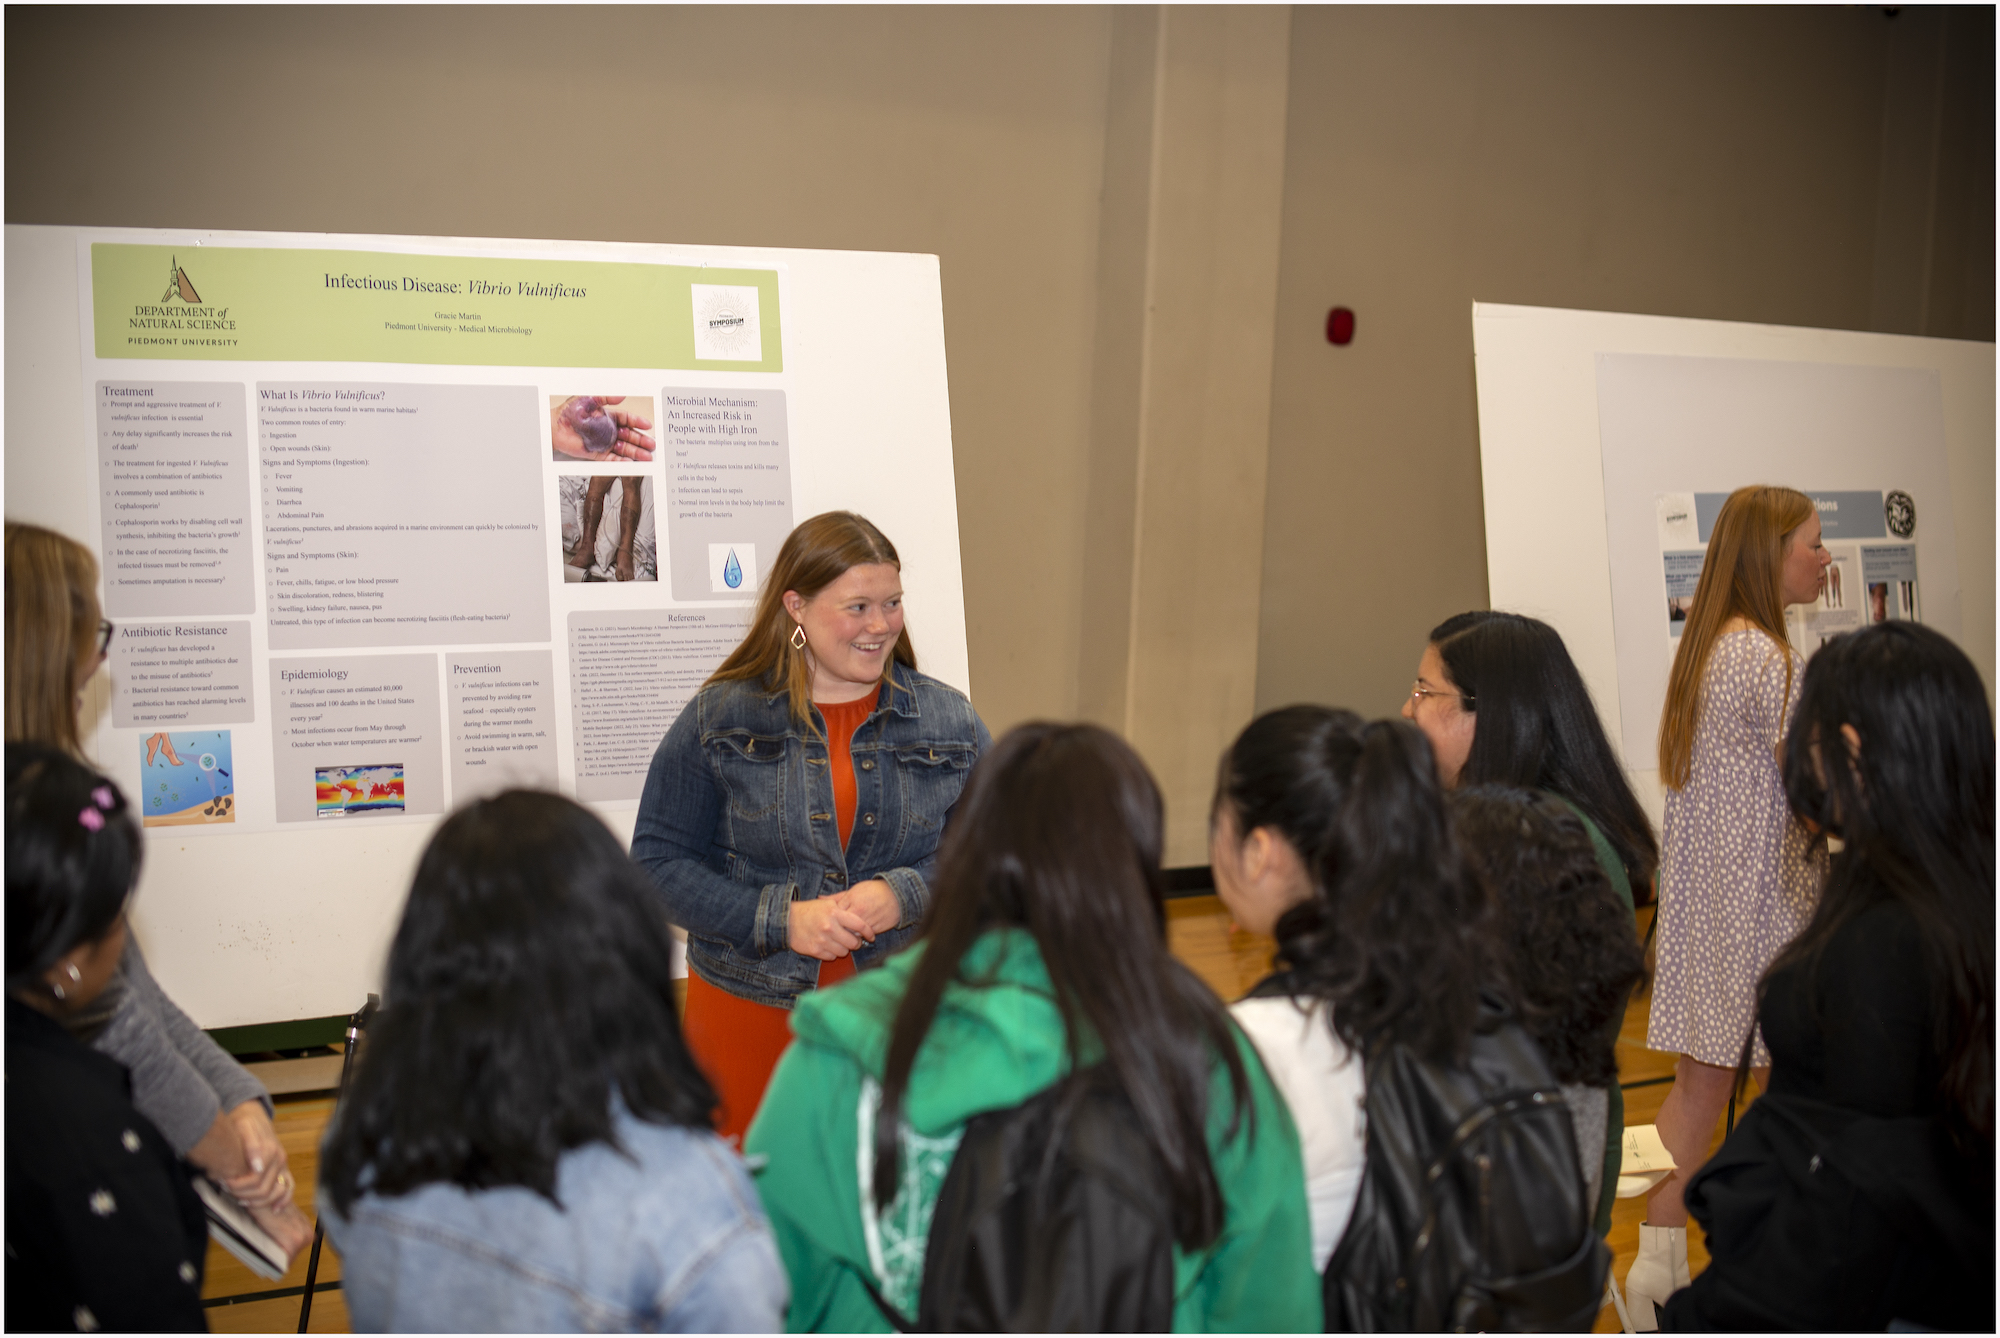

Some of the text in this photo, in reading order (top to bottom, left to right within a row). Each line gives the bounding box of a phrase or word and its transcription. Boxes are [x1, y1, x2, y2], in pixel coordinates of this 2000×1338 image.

[325, 274, 586, 300] Infectious Disease: Vibrio Vulnificus
[135, 305, 229, 320] DEPARTMENT of
[434, 312, 481, 320] Gracie Martin
[130, 318, 236, 330] NATURAL SCIENCE
[709, 318, 744, 327] SYMPOSIUM
[385, 322, 533, 336] Piedmont University Medical Microbiology
[128, 337, 178, 345] PIEDMONT
[103, 386, 154, 396] Treatment
[260, 390, 385, 402] What Is Vibrio Vulnificus?
[110, 400, 133, 409] Prompt
[146, 401, 178, 409] aggressive
[667, 396, 758, 407] Microbial Mechanism:
[668, 410, 752, 421] An Increased Risk in
[112, 430, 125, 438] Any
[126, 430, 143, 438] delay
[144, 430, 181, 438] significantly
[668, 423, 758, 436] People with High Iron
[270, 432, 297, 440] Ingestion
[270, 445, 286, 453] Open
[166, 460, 191, 468] ingested
[263, 459, 331, 467] Signs Symptoms
[121, 489, 153, 497] commonly
[276, 486, 303, 494] Vomiting
[115, 519, 159, 527] Cephalosporin
[189, 518, 217, 526] disabling
[374, 524, 398, 532] acquired
[147, 532, 176, 540] inhibiting
[158, 548, 192, 556] necrotizing
[267, 552, 285, 561] Signs
[300, 552, 335, 560] Symptoms
[153, 578, 187, 586] amputation
[668, 614, 706, 622] References
[121, 626, 228, 638] Antibiotic Resistance
[179, 644, 210, 652] developed
[169, 658, 194, 666] multiple
[454, 663, 501, 674] Prevention
[281, 669, 348, 682] Epidemiology
[132, 686, 159, 694] Bacterial
[191, 684, 212, 692] toward
[355, 685, 382, 693] estimated
[132, 700, 164, 708] antibiotics
[177, 698, 200, 706] reached
[462, 694, 489, 703] prevented
[490, 706, 516, 715] especially
[482, 732, 510, 740] swimming
